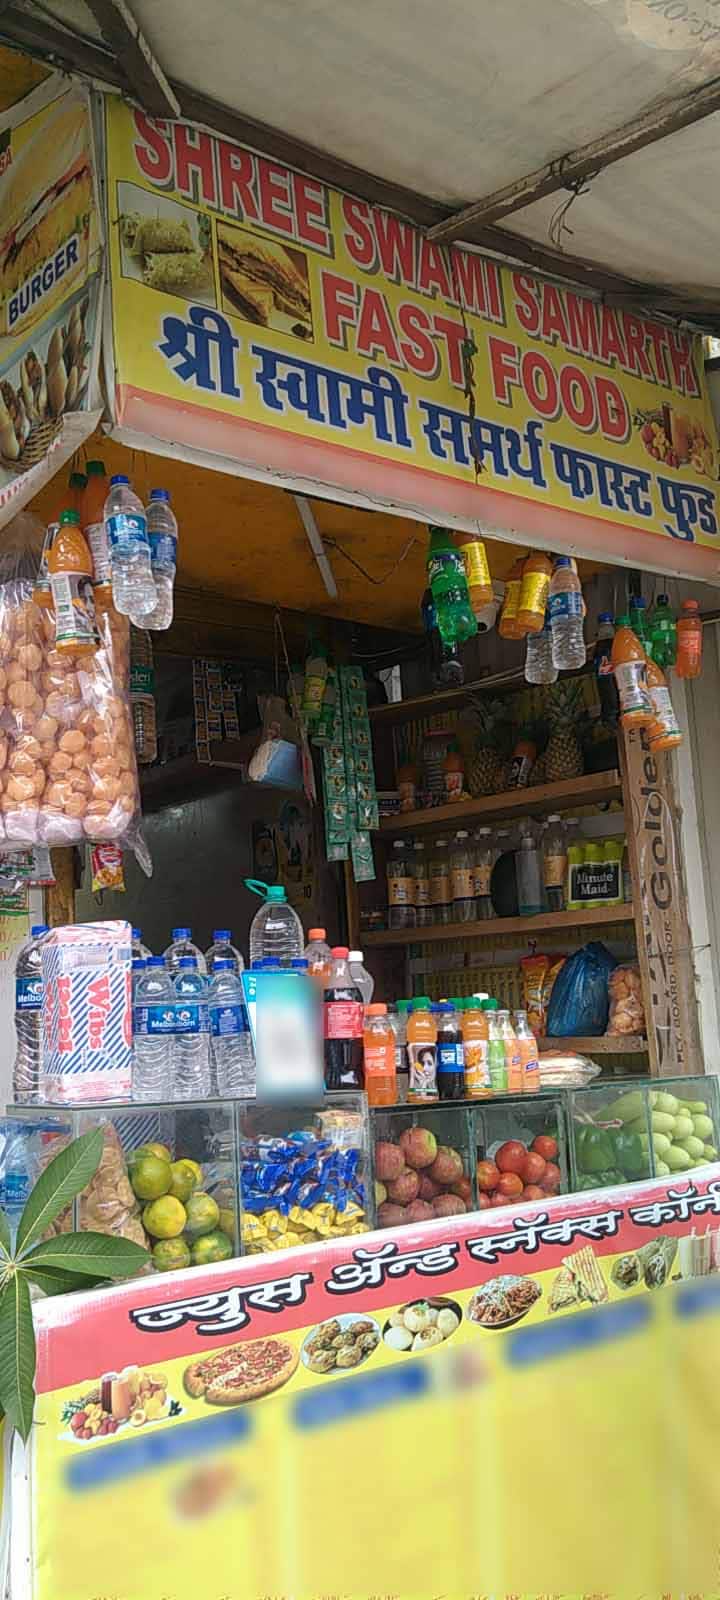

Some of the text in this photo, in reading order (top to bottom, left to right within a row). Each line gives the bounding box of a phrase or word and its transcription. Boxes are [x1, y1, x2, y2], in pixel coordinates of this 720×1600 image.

[7, 240, 79, 327] BURGER
[133, 109, 701, 396] SHREE SWAMI SAMARTH
[321, 270, 631, 444] FAST FOOD
[158, 305, 241, 399] श्री
[250, 345, 412, 450] स्वामी
[418, 399, 546, 490] समर्थ
[550, 442, 652, 517] फास्ट
[576, 872, 614, 885] Minute
[580, 882, 608, 895] Maid
[87, 974, 111, 1050] Wibs
